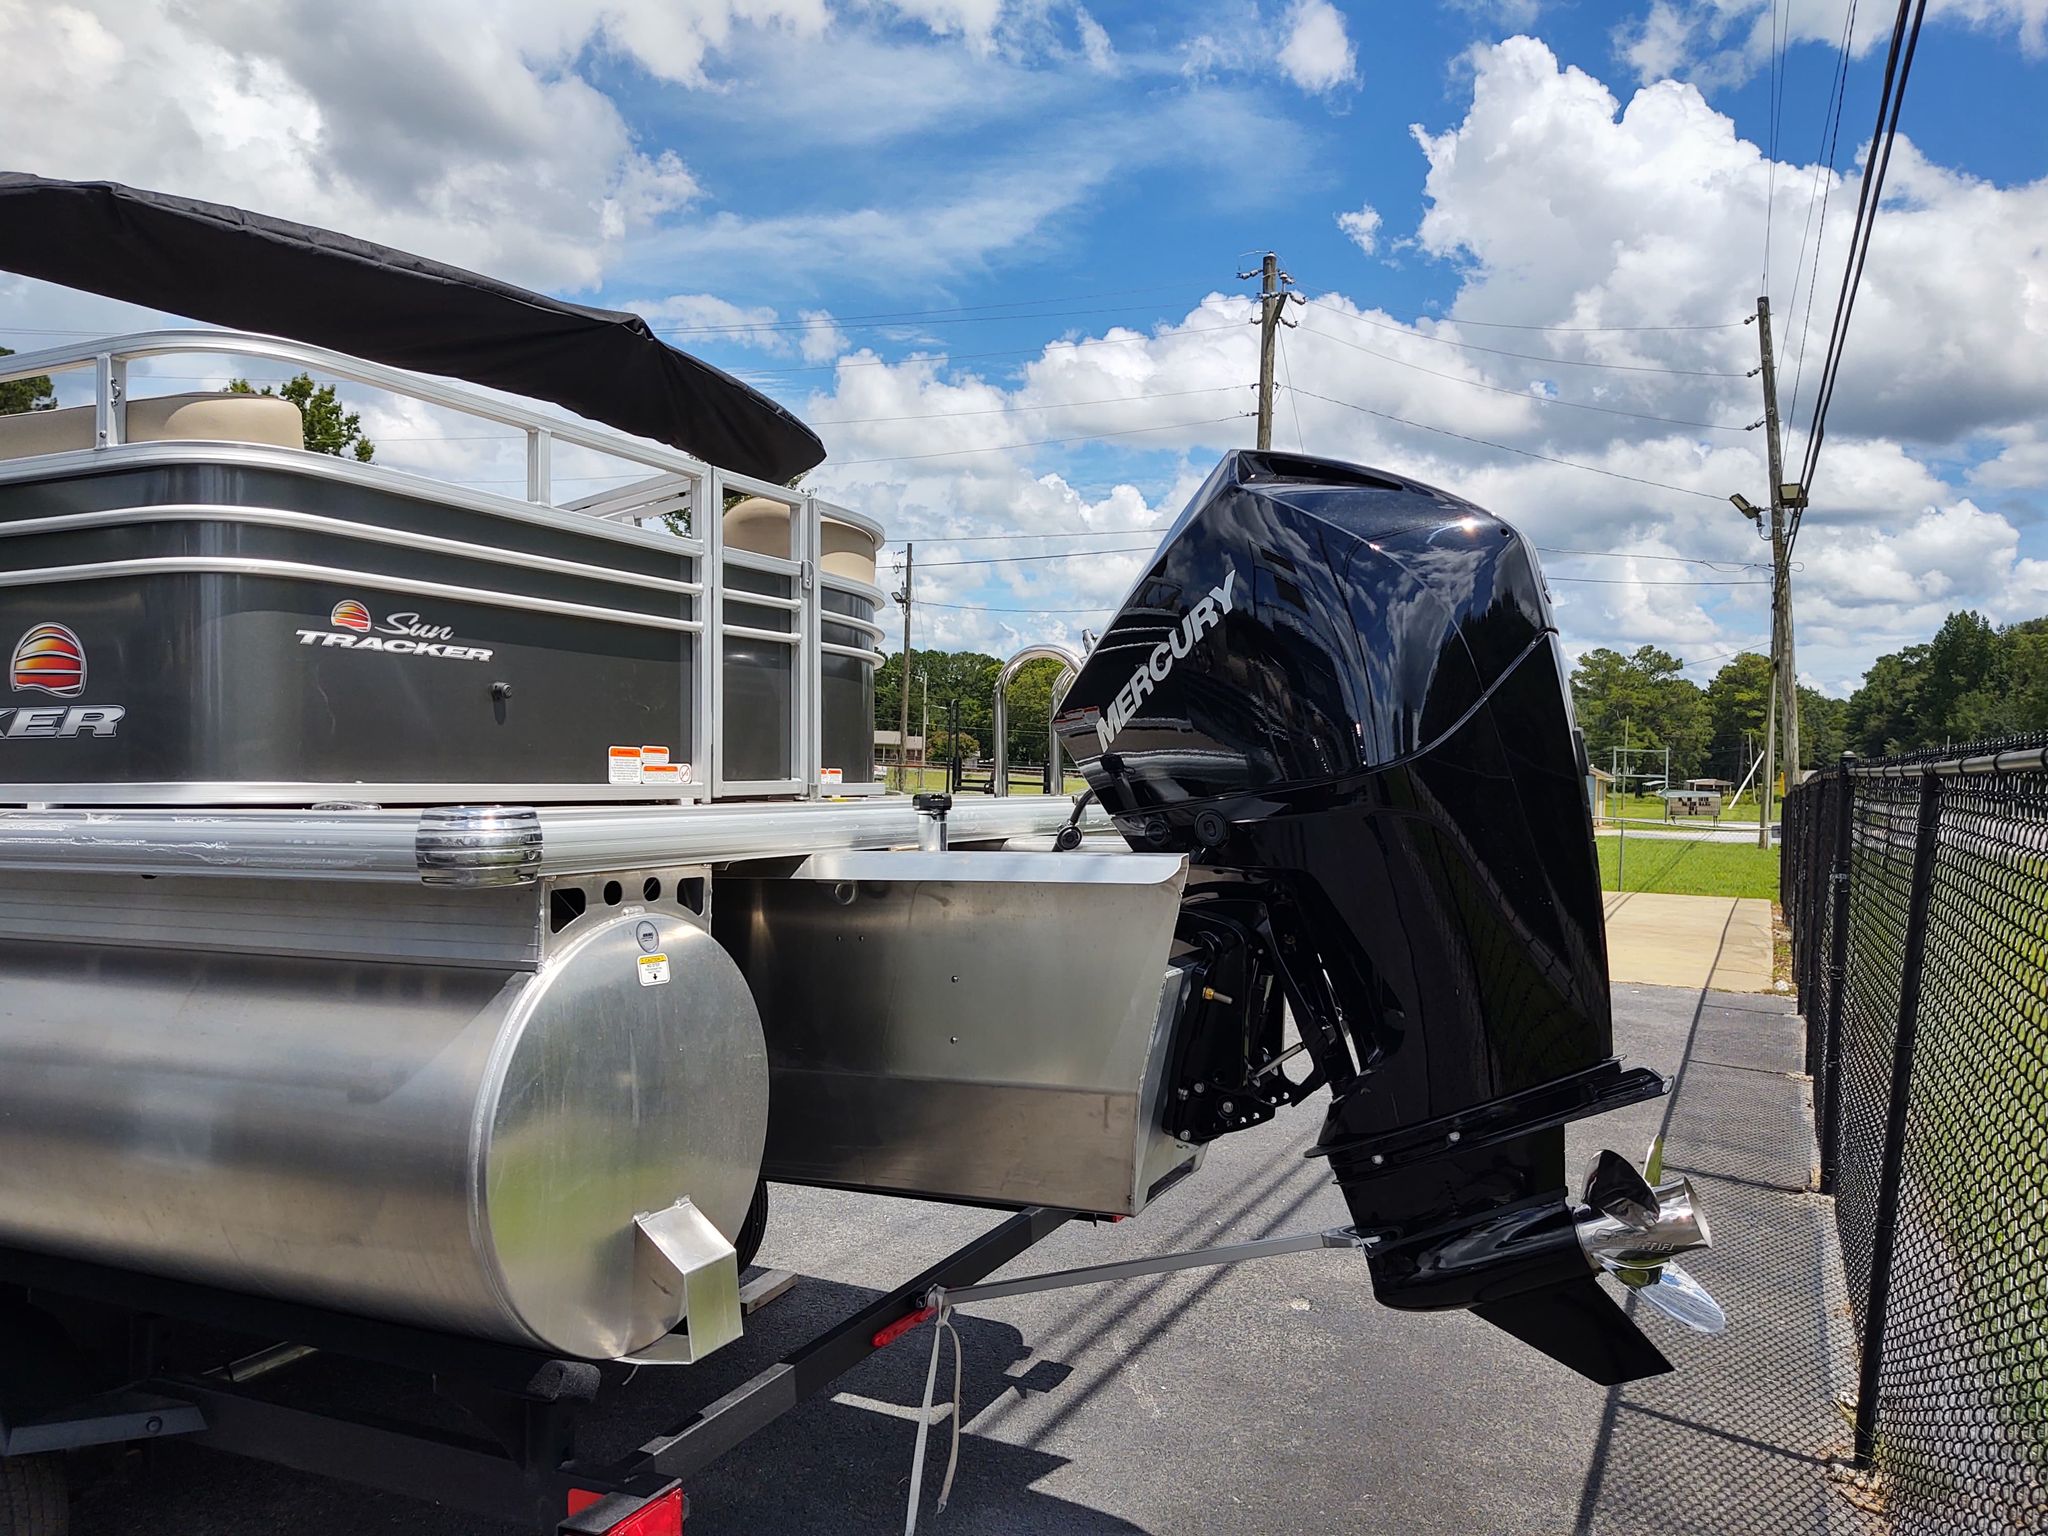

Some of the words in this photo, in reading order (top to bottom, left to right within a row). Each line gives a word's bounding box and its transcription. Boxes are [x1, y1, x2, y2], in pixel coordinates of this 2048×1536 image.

[374, 612, 454, 640] Sun
[296, 629, 494, 662] TRACKER
[1096, 569, 1236, 753] MERCURY
